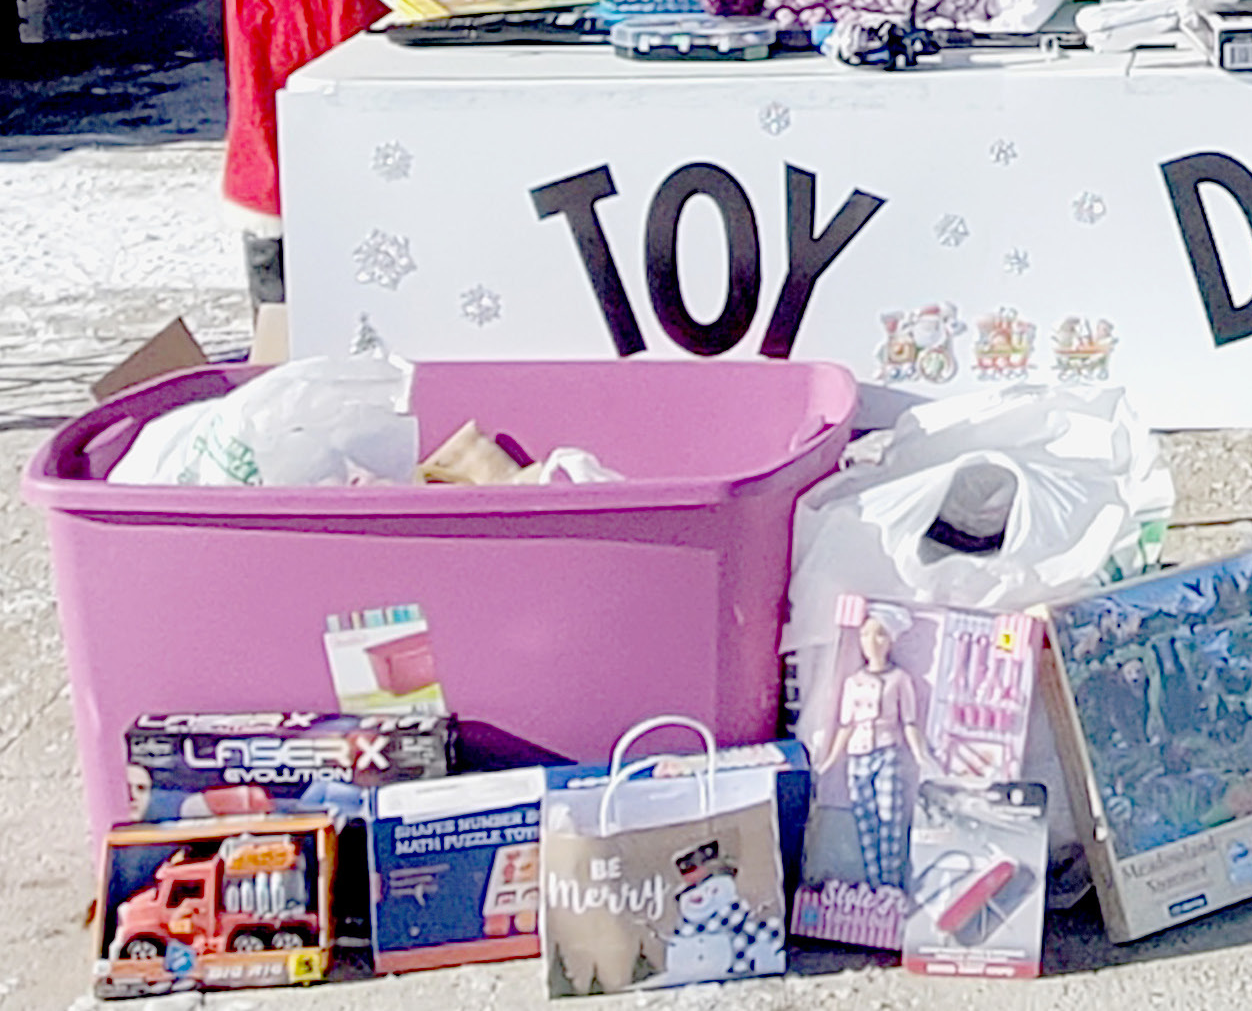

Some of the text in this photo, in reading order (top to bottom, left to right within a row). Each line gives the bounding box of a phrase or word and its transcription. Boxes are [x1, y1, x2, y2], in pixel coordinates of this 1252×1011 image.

[529, 161, 888, 360] TOY
[182, 737, 352, 769] LASER
[222, 766, 354, 784] EVOLUTION
[590, 856, 623, 881] BE
